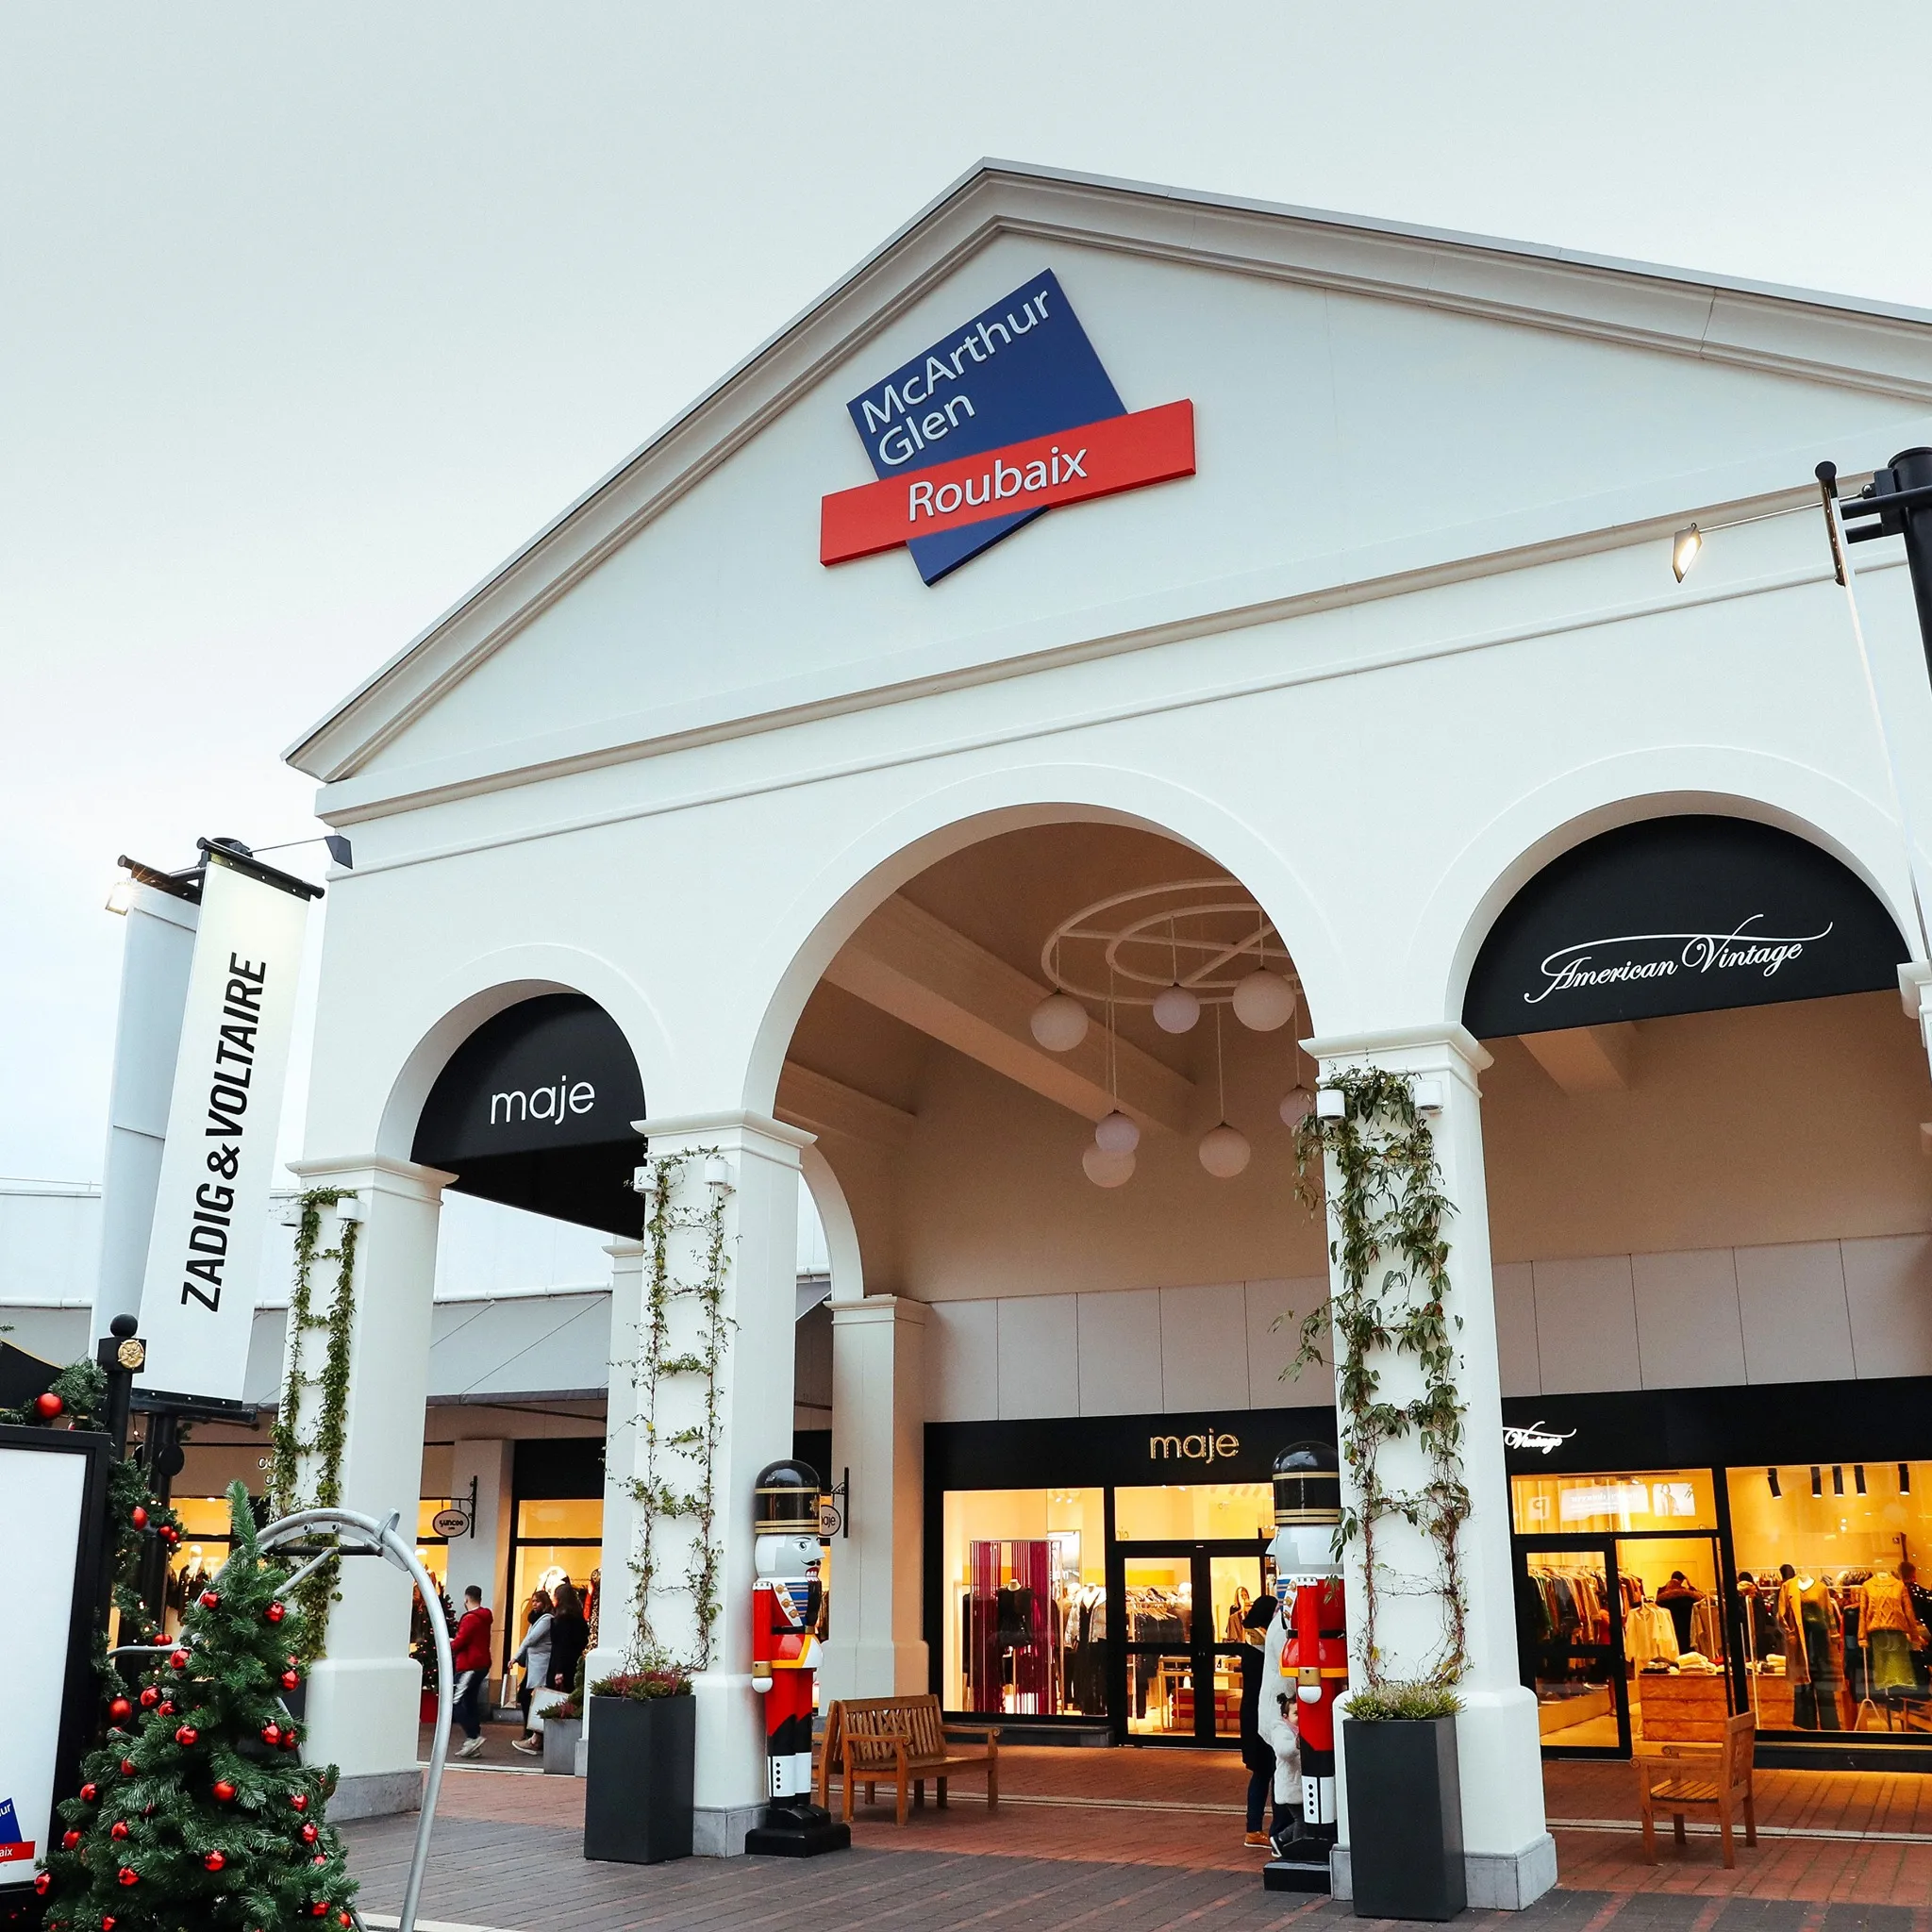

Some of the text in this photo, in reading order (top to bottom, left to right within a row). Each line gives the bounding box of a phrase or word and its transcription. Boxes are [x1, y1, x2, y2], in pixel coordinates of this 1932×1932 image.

[861, 290, 1050, 433] McArthur
[878, 394, 976, 465] Glen
[908, 446, 1089, 522] Roubaix
[1524, 914, 1805, 1004] American Vintage
[180, 952, 267, 1313] ZADIG & VOLTAIRE
[490, 1074, 596, 1125] maje
[1150, 1427, 1241, 1464] maje
[821, 1513, 836, 1528] aje
